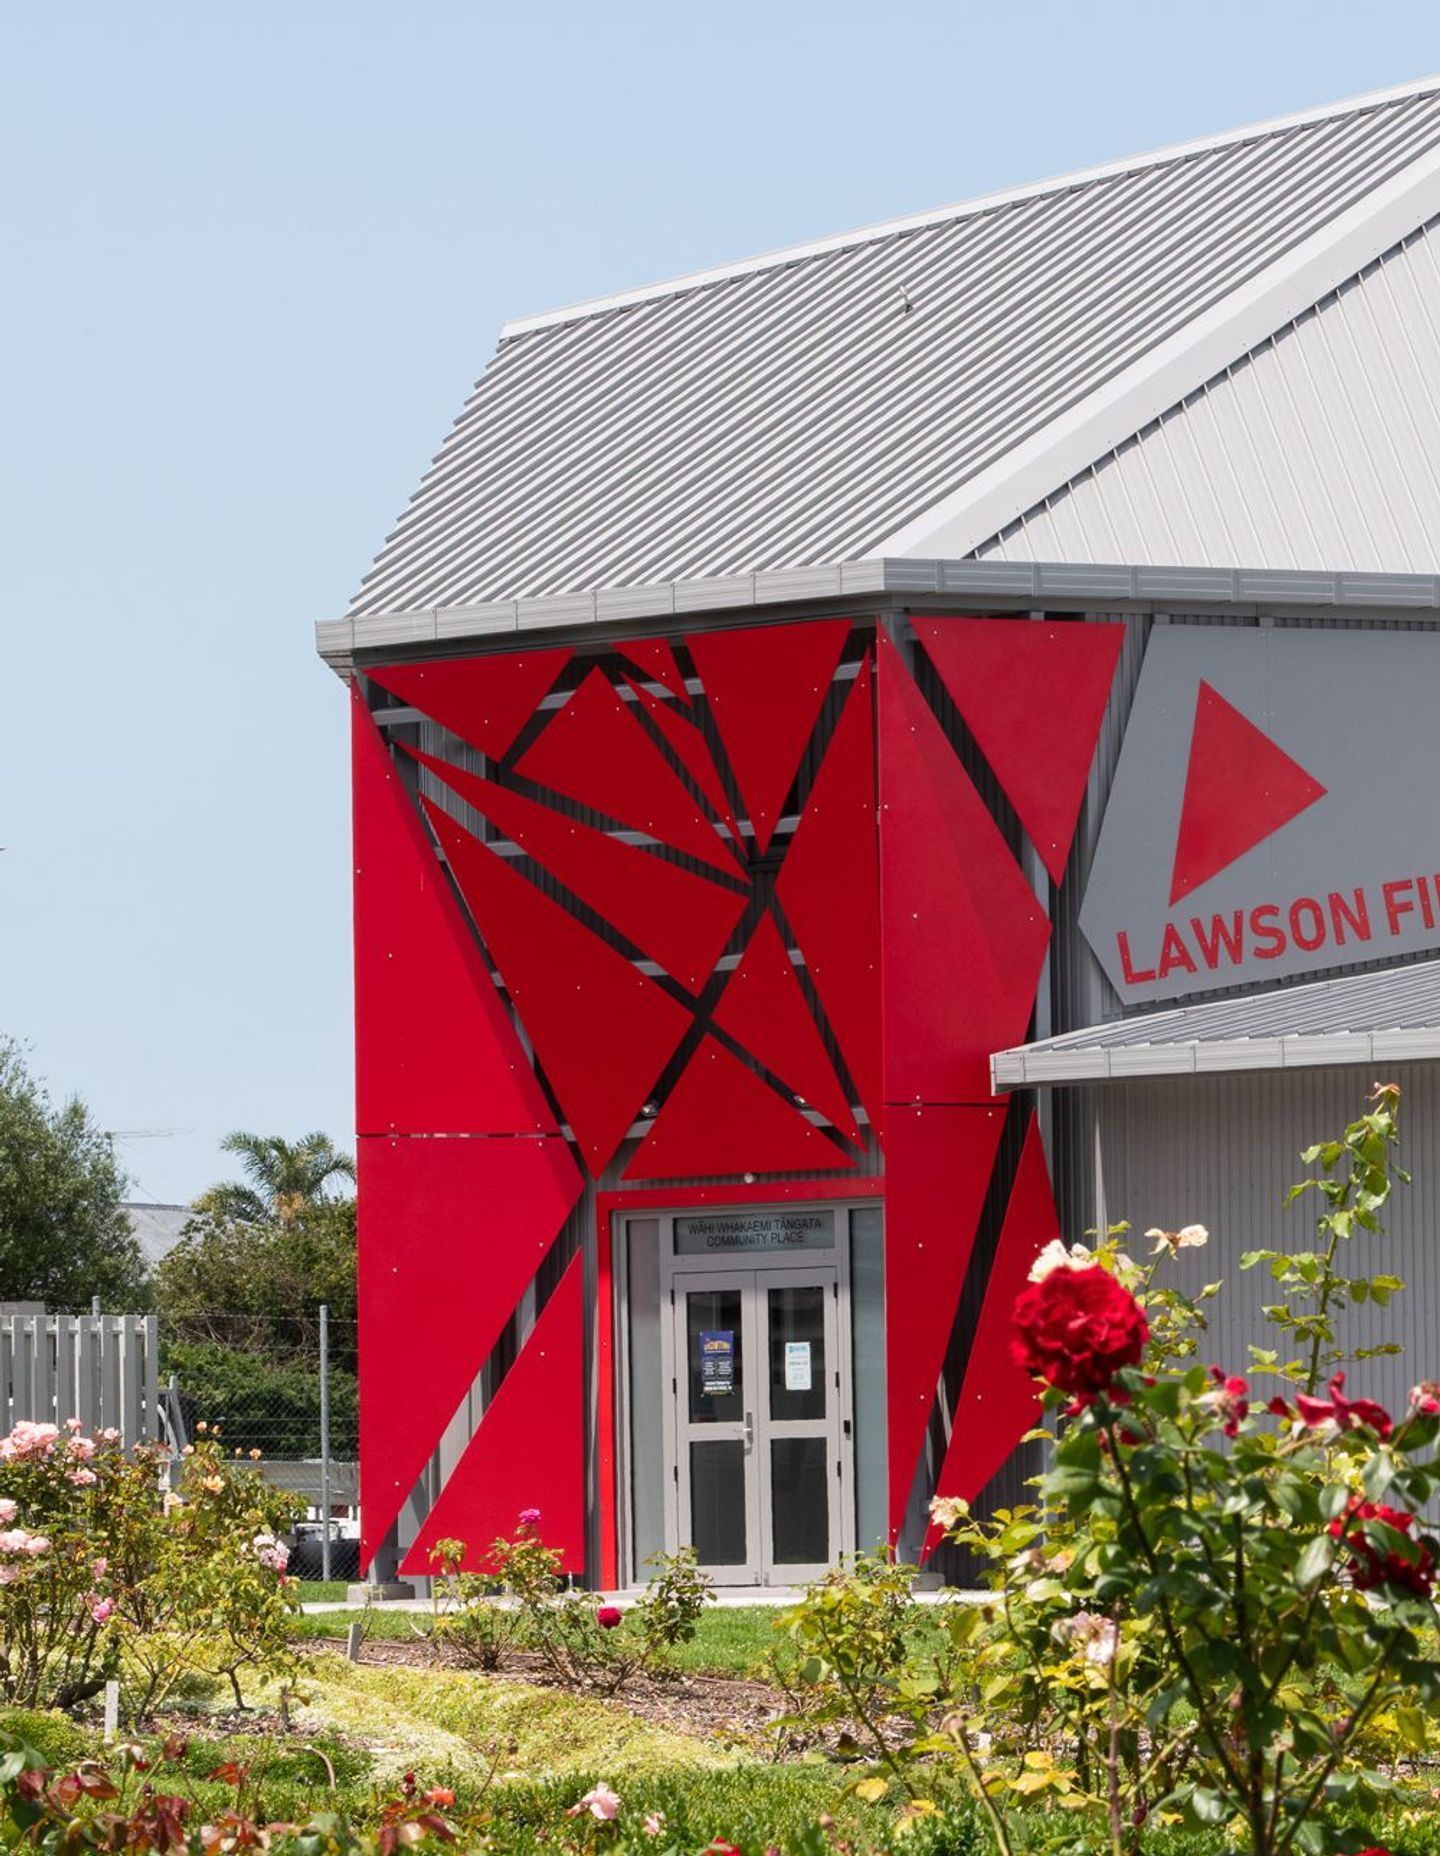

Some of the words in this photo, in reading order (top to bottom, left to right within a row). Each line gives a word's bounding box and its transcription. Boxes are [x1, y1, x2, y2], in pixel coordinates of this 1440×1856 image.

[1116, 888, 1371, 985] LAWSON
[717, 1220, 771, 1233] WHAKAEMI
[707, 1233, 767, 1247] COMMUNITY
[771, 1231, 804, 1243] PLACE
